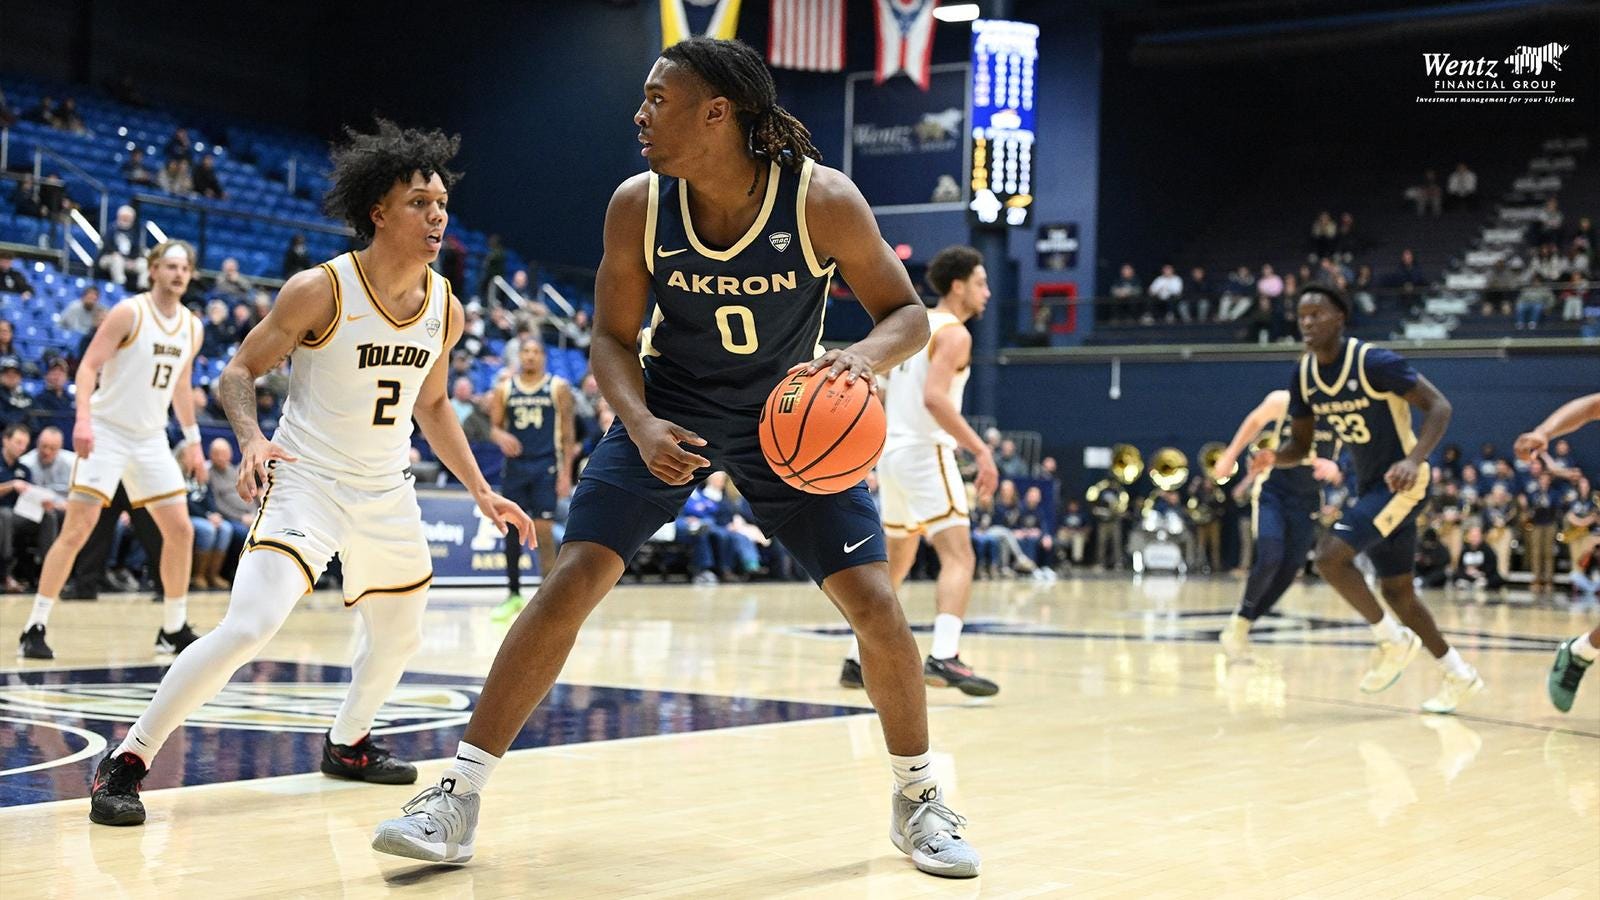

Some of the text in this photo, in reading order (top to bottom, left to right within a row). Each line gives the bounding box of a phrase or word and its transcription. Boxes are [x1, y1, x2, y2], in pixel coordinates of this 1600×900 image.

[667, 270, 797, 295] AKRON
[714, 305, 759, 355] 0
[356, 343, 431, 369] TOLEDO
[152, 363, 173, 389] 13
[372, 379, 401, 426] 2
[513, 406, 543, 430] 34
[1326, 413, 1371, 444] 23
